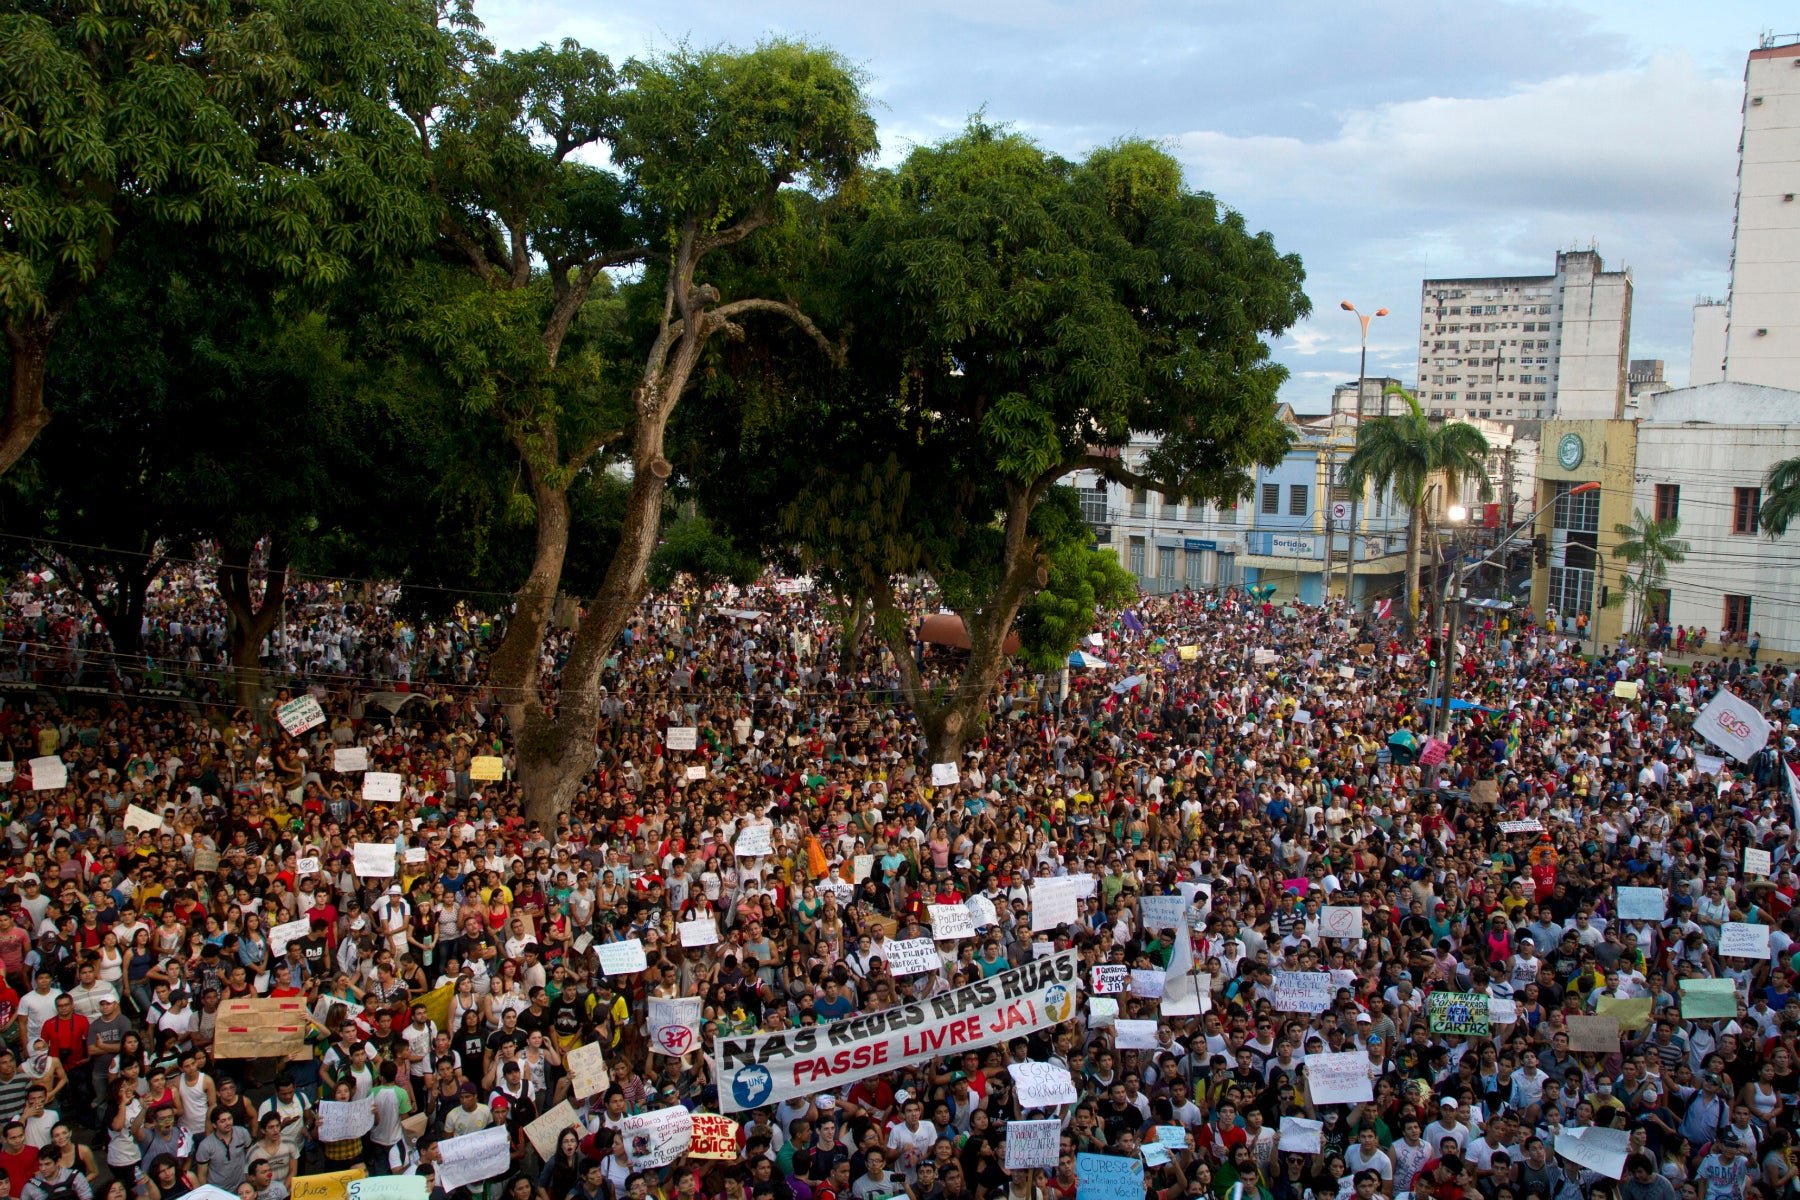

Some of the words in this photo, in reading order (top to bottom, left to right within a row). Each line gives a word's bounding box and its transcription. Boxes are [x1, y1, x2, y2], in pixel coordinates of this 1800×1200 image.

[1719, 710, 1751, 739] UJS
[305, 946, 323, 958] D&B
[887, 951, 901, 960] UM
[905, 962, 930, 973] LUTA!
[1276, 970, 1299, 981] ENTRE
[1279, 980, 1294, 989] MIL
[1048, 992, 1065, 1004] UBES
[1453, 992, 1480, 1001] TANTA
[1276, 1000, 1298, 1010] MAIS
[722, 1028, 818, 1071] NAS
[827, 1003, 924, 1047] REDES
[930, 981, 997, 1019] NAS
[999, 954, 1074, 999] RUAS
[1448, 1007, 1468, 1015] NEM
[1469, 1008, 1489, 1016] CABE
[1438, 1014, 1453, 1022] EM
[1434, 1021, 1488, 1035] CARTAZ
[793, 1040, 889, 1087] PASSE
[903, 1015, 984, 1057] LIVRE
[747, 1074, 766, 1087] UNE
[1034, 1072, 1056, 1084] DA
[623, 1116, 644, 1131] NÃO
[656, 1118, 690, 1132] corruptos
[691, 1115, 733, 1125] EMOS
[693, 1123, 730, 1137] FOME
[1113, 1186, 1139, 1198] Você!
